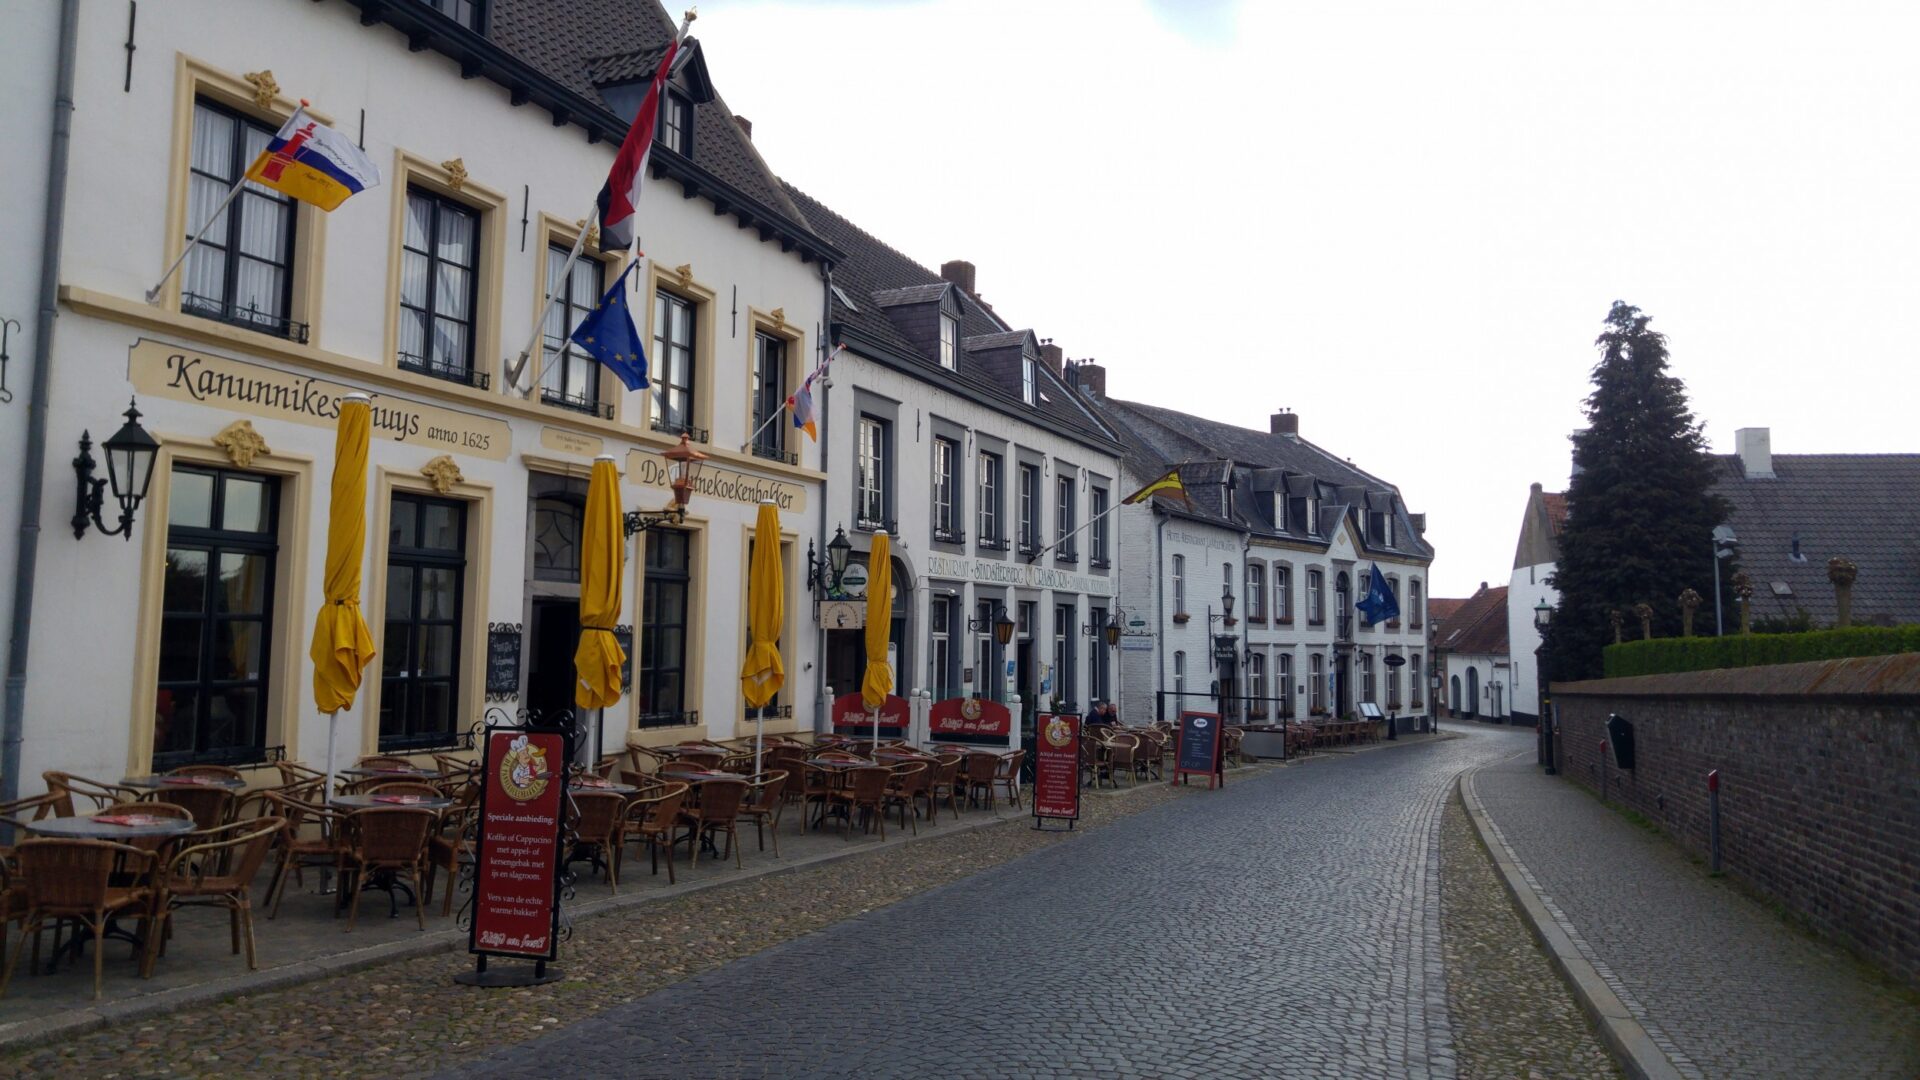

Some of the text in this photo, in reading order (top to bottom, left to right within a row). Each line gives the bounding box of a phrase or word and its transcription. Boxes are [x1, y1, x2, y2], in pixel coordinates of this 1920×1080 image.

[427, 426, 458, 443] anno
[461, 431, 490, 450] 1625
[641, 459, 665, 486] De
[488, 812, 514, 822] Speciale
[487, 832, 552, 845] Koffie of Cappucino
[511, 847, 531, 857] appel-
[532, 848, 541, 856] of
[490, 856, 530, 868] kersengebak
[491, 869, 541, 881] ijs en slagroom.
[488, 892, 502, 902] Vers
[515, 895, 525, 903] de
[525, 896, 544, 905] echte
[490, 907, 538, 917] warme bakker!
[480, 930, 506, 948] Altijd
